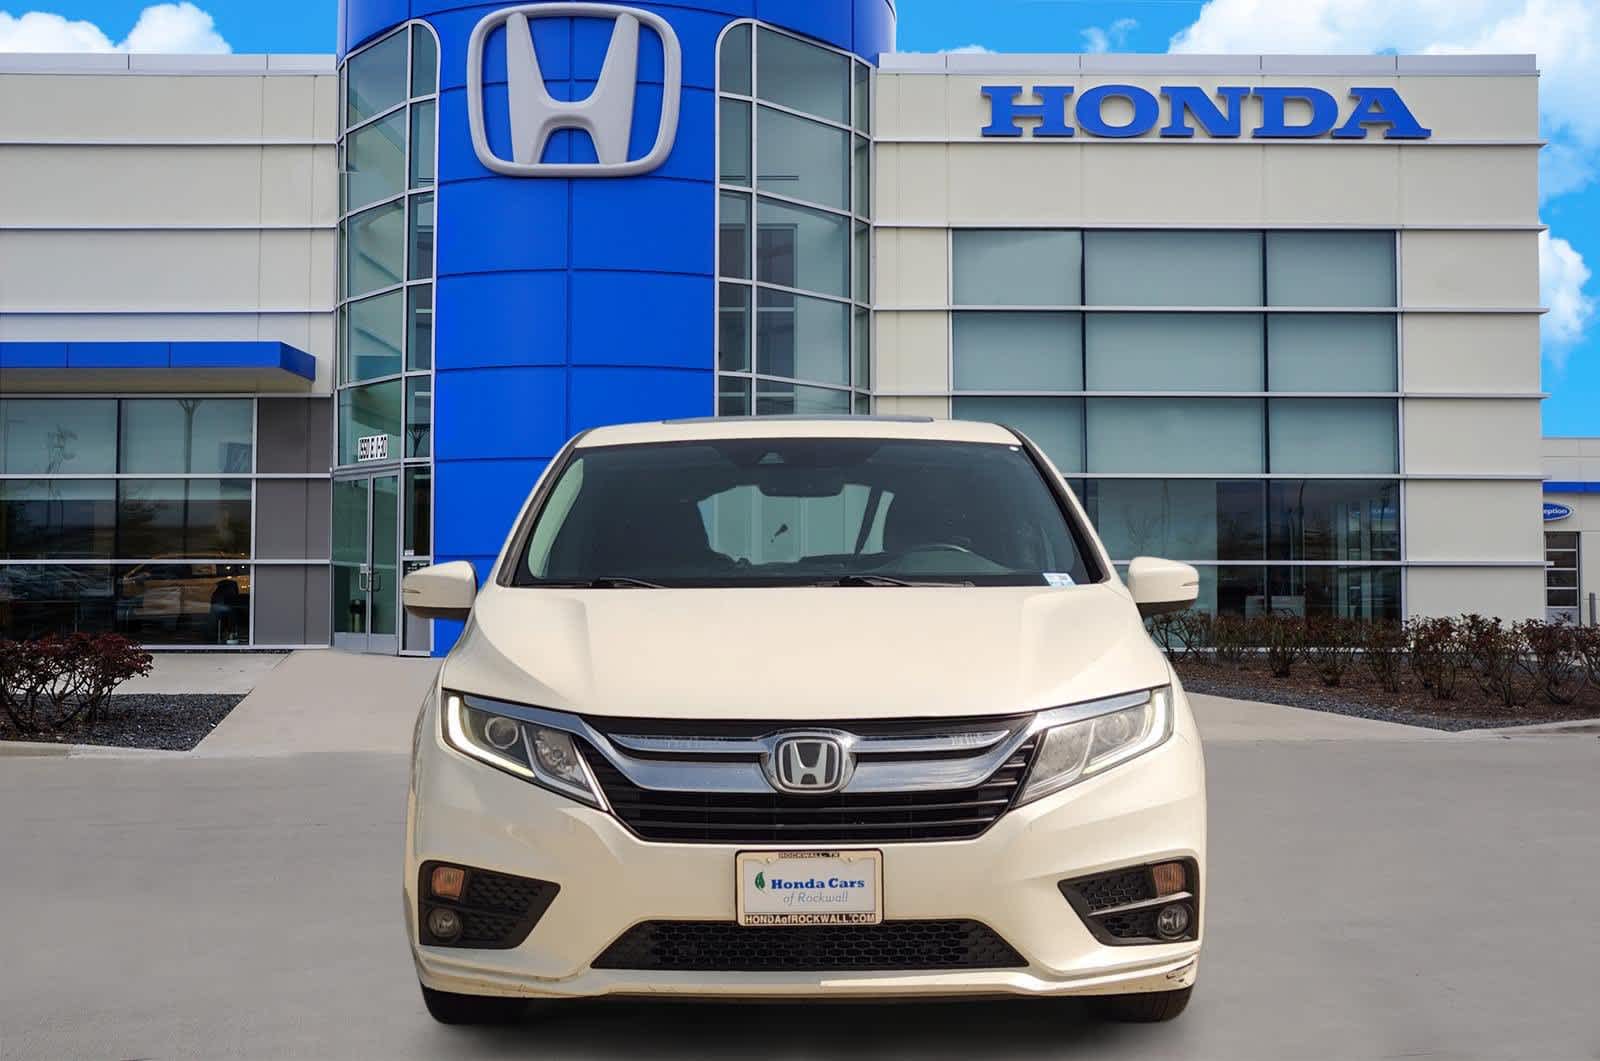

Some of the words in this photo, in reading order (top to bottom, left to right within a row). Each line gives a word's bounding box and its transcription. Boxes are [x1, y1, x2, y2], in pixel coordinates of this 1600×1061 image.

[981, 85, 1431, 139] HONDA
[771, 878, 825, 890] Honda
[828, 877, 865, 889] Cars
[783, 893, 795, 906] of
[797, 891, 849, 904] Rockwall
